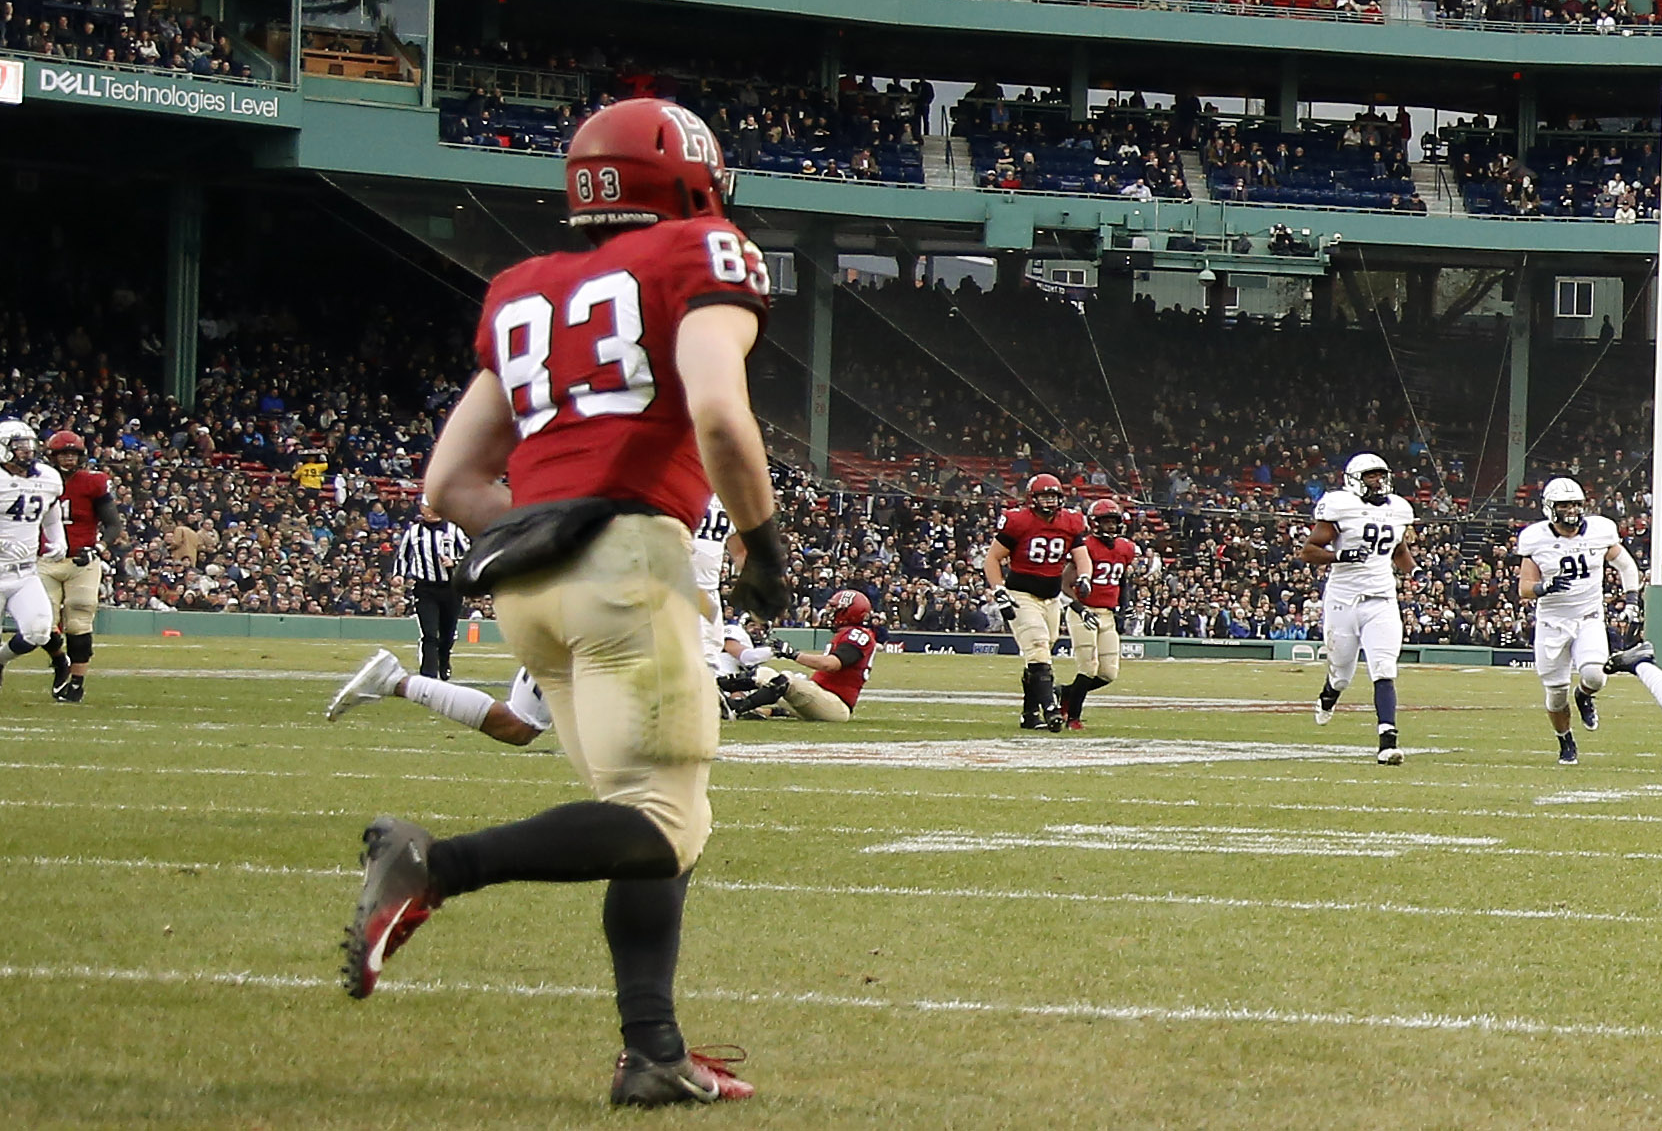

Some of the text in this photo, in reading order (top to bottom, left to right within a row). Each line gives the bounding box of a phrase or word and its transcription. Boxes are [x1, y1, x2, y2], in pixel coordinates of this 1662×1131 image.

[40, 68, 279, 118] DELL Technologies Level
[661, 106, 718, 167] H
[577, 167, 621, 203] 83
[706, 231, 771, 296] 83
[494, 269, 656, 438] 83
[6, 494, 43, 523] 43
[1028, 536, 1065, 563] 69
[1363, 522, 1395, 556] 92
[1092, 562, 1124, 586] 20
[1560, 553, 1590, 580] 91
[848, 628, 871, 646] 58
